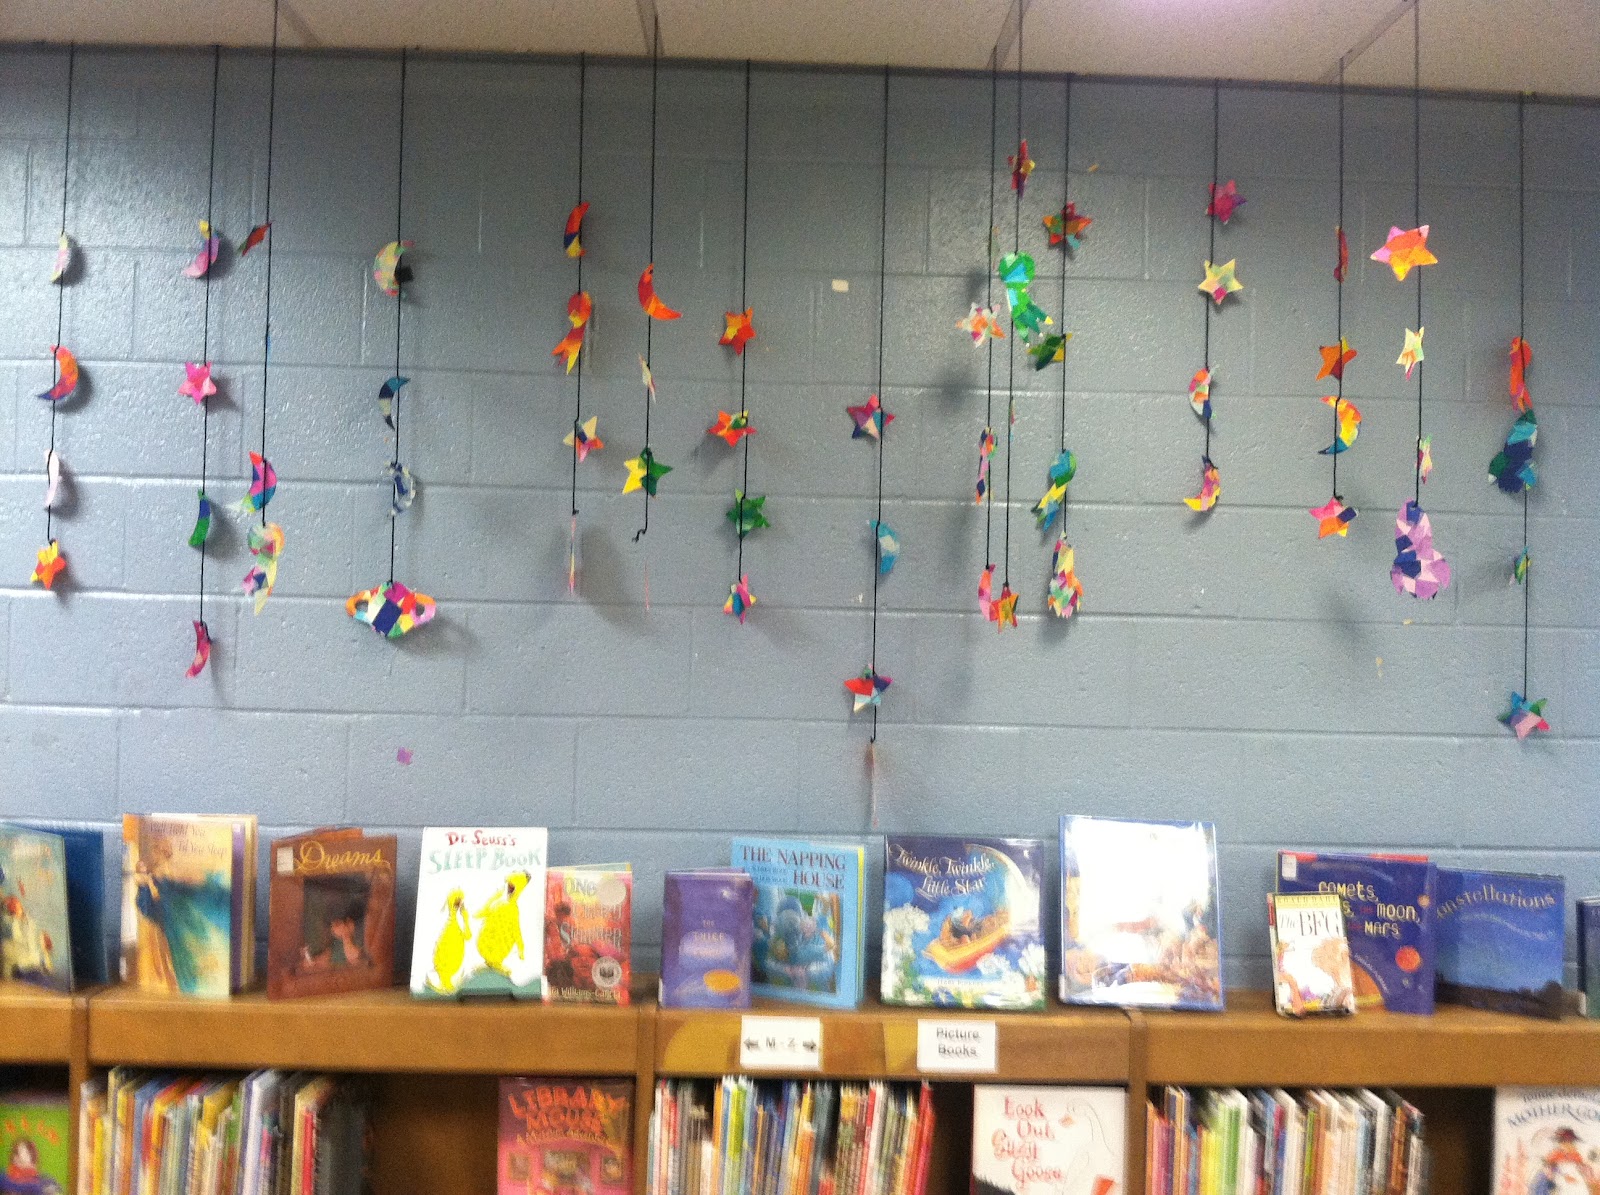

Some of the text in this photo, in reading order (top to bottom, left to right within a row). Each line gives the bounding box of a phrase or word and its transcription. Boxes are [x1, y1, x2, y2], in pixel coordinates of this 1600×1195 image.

[446, 829, 517, 846] Dr. Seuss's
[295, 840, 388, 872] Dreams
[740, 845, 772, 862] THE
[777, 848, 846, 871] NAPPING
[793, 869, 845, 889] HOUSE
[916, 875, 986, 901] Little Star
[1436, 884, 1555, 919] onstellations
[1279, 911, 1341, 937] The BFG
[765, 1037, 777, 1049] M
[787, 1037, 797, 1049] Z
[936, 1028, 980, 1040] Picture
[938, 1044, 977, 1057] Books
[1003, 1095, 1046, 1119] Look
[1508, 1103, 1585, 1127] MOTHER
